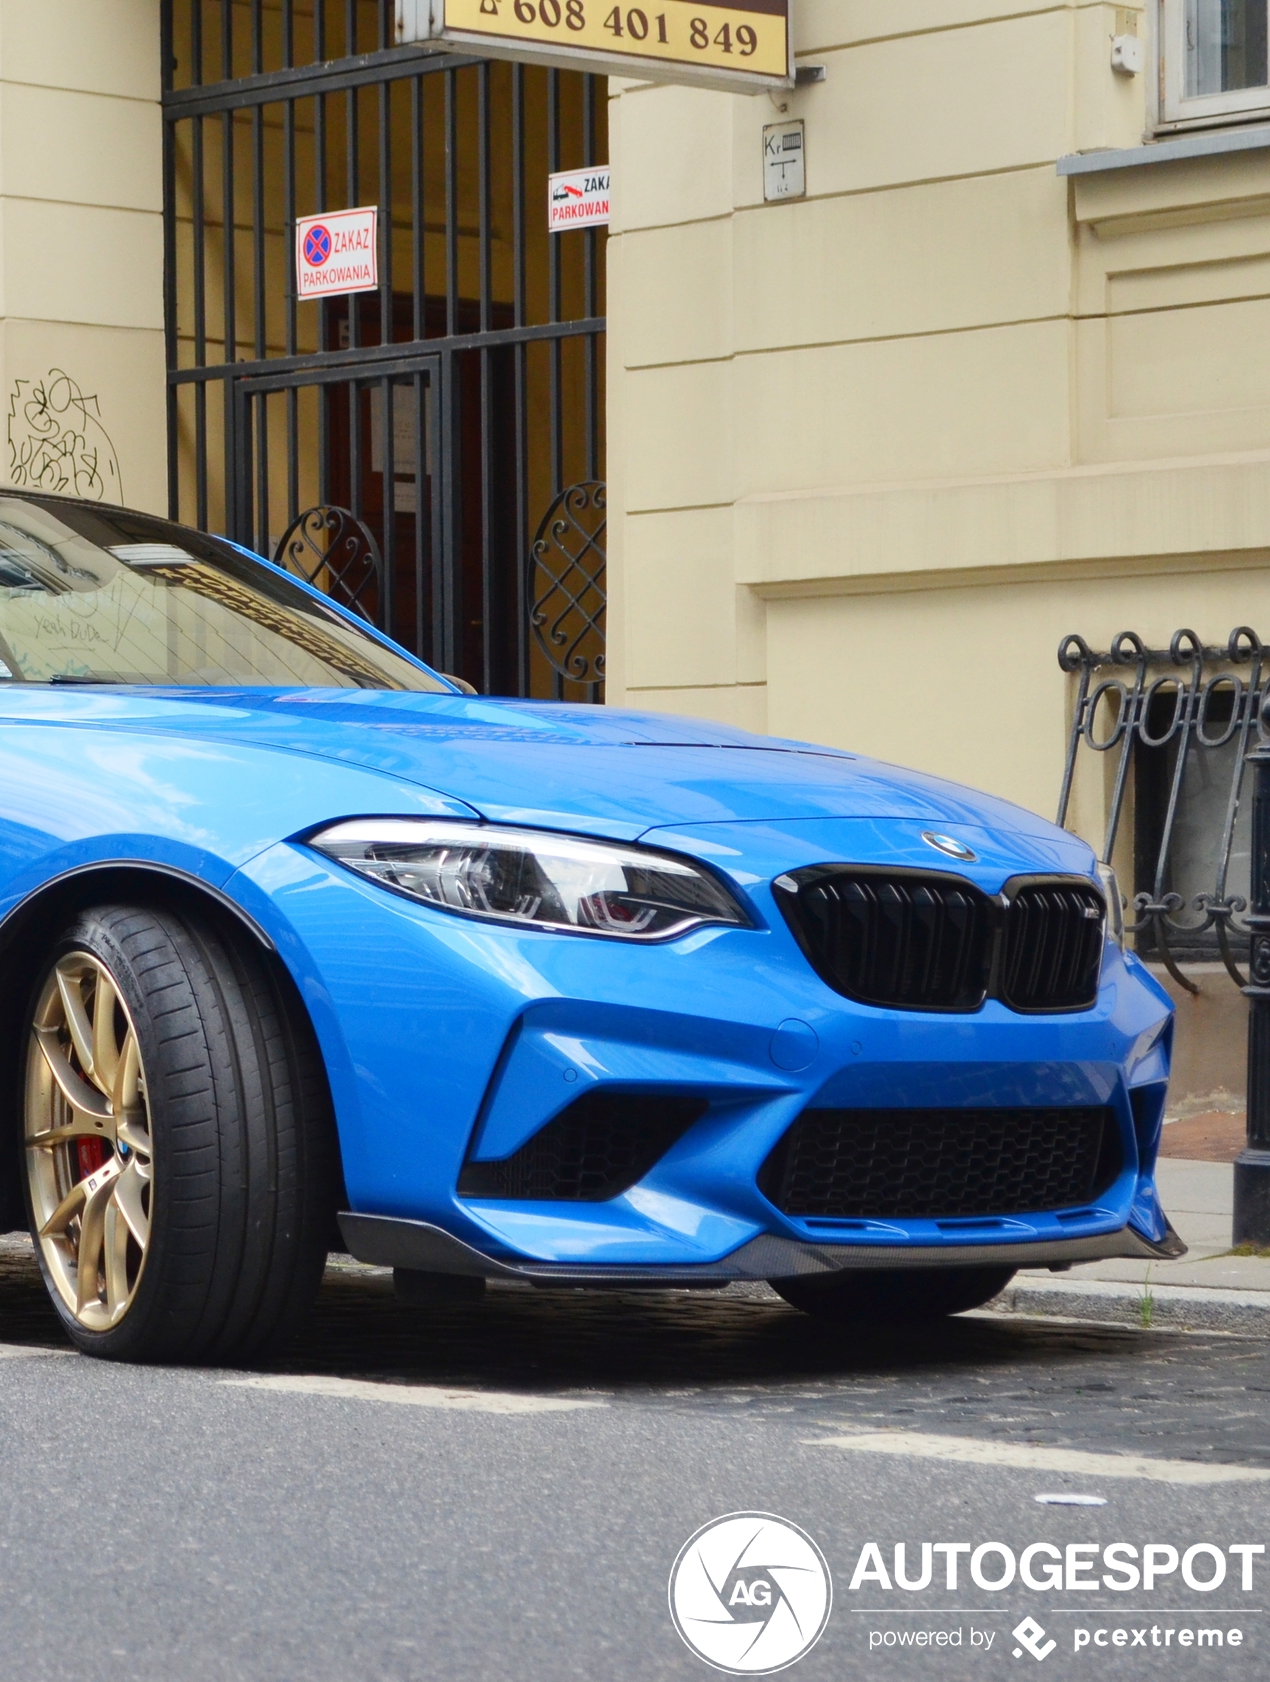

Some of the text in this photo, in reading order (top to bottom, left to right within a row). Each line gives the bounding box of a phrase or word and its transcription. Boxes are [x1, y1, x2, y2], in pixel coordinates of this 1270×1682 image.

[514, 0, 758, 56] 608 401 849
[334, 228, 369, 253] ZAKAZ
[304, 264, 371, 287] PARKOWANIA
